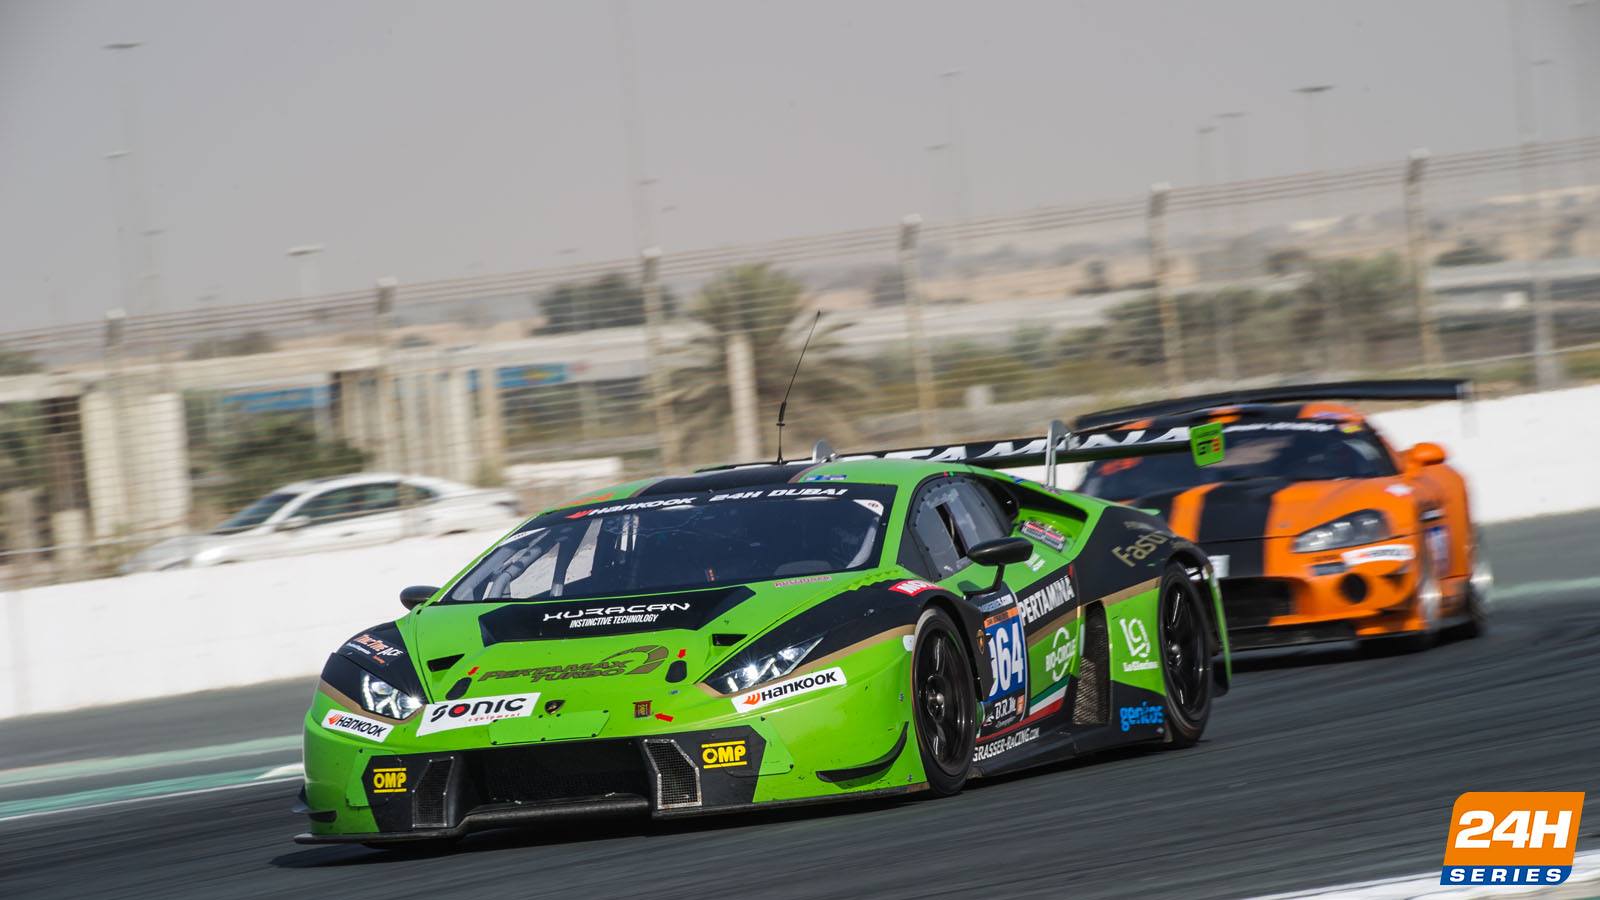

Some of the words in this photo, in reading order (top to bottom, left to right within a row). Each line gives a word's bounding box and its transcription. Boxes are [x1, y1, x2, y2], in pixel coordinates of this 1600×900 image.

[708, 490, 763, 502] 24H
[767, 488, 848, 497] DUBAI
[1018, 575, 1075, 627] PERTAMINA
[543, 603, 690, 621] HURACAN
[569, 616, 612, 628] INSTINCTIVE
[612, 614, 659, 625] TECHNOLOGY
[478, 660, 634, 682] PERTAMAX
[531, 668, 625, 683] TURBO
[468, 713, 520, 722] equipment
[702, 742, 746, 764] OMP
[373, 772, 407, 789] OMP
